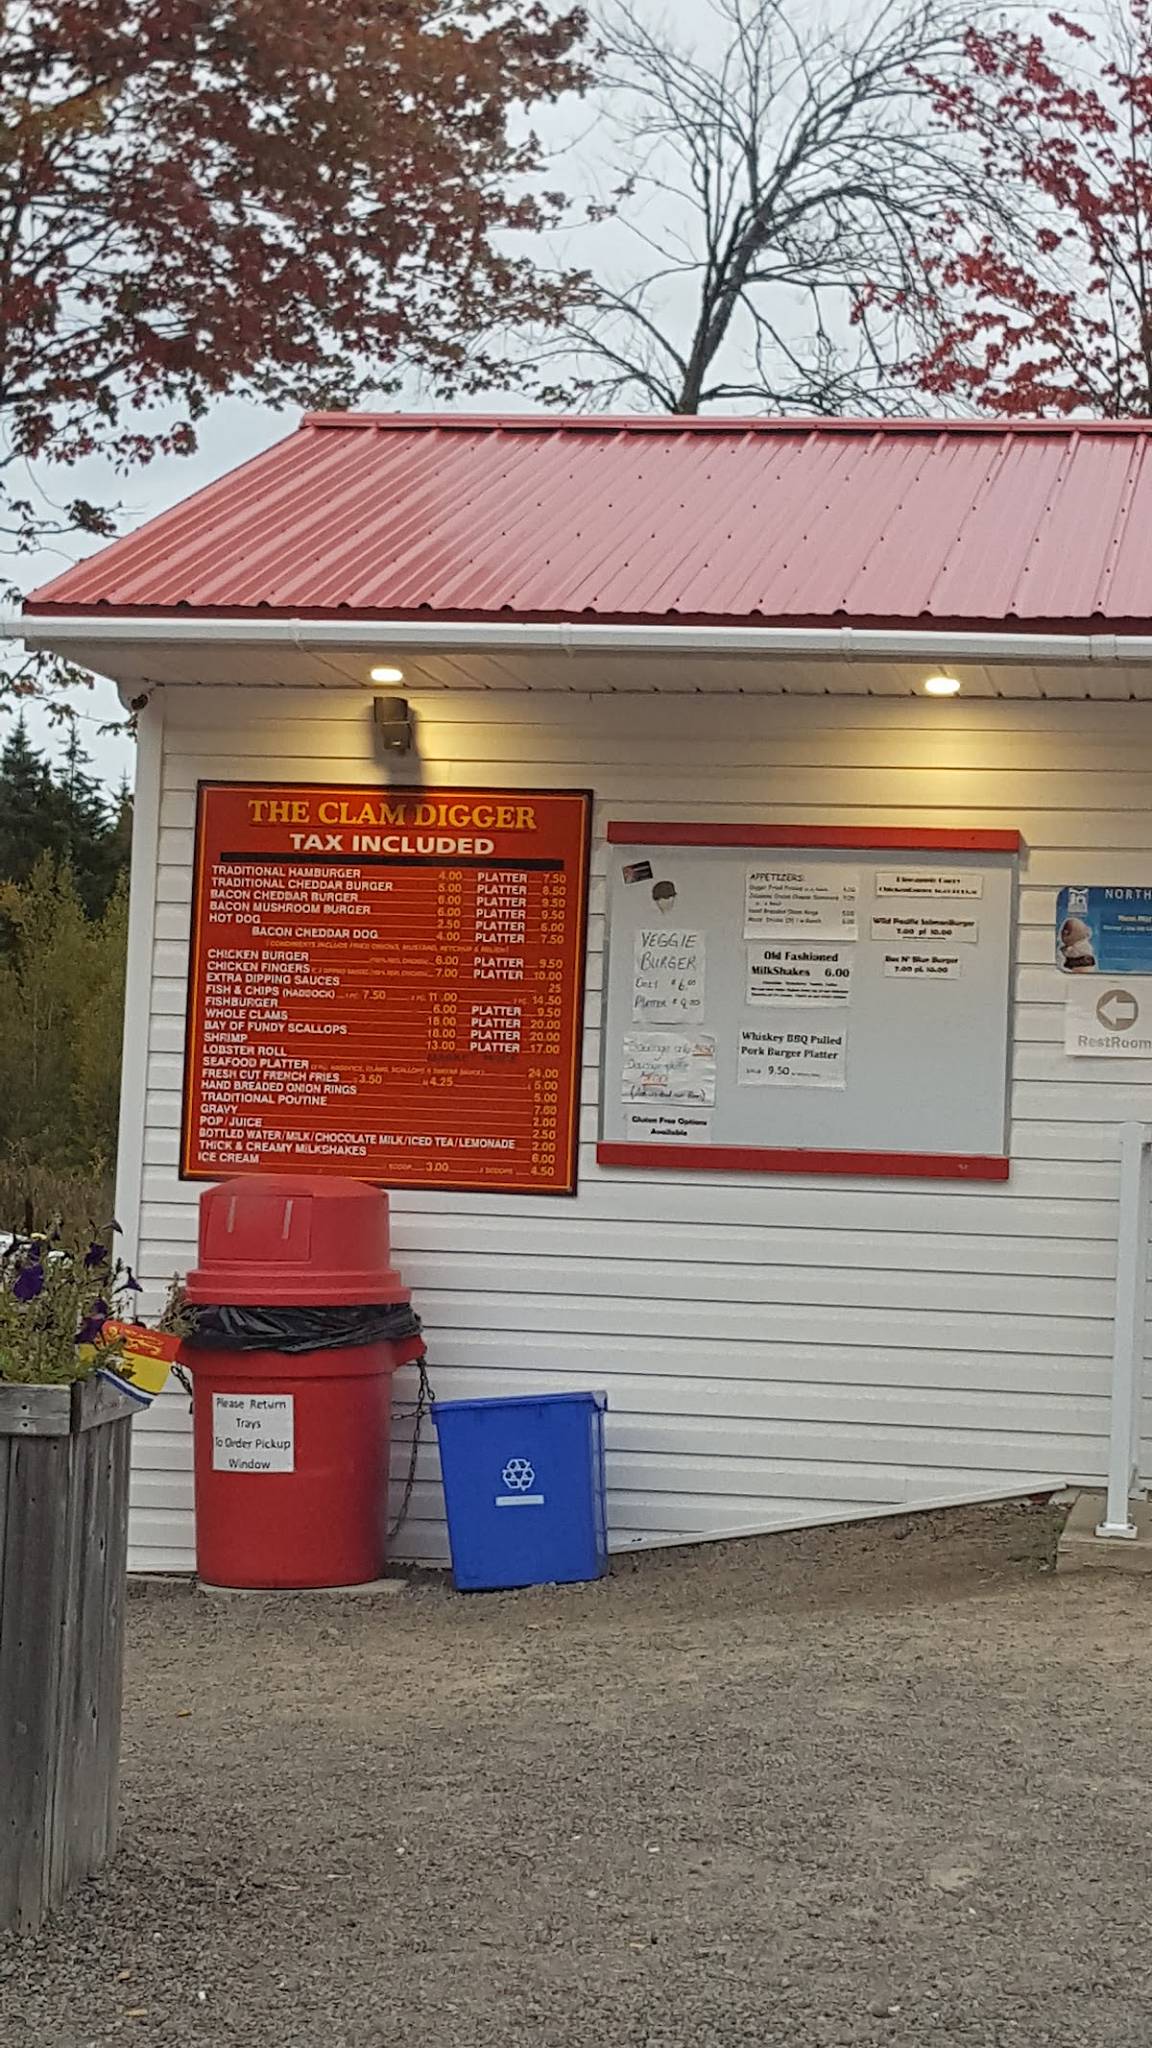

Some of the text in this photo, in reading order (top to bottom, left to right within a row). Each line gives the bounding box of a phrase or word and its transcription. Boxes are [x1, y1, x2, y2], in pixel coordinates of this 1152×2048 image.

[248, 800, 536, 829] THE CLAM DIGGER
[290, 833, 494, 854] TAX INCLUDED
[212, 865, 285, 876] TRADITIONAL
[288, 868, 360, 878] HAMBURGER
[477, 872, 527, 883] PLATTER
[543, 874, 566, 884] 7.50
[211, 877, 285, 888] TRADITIONAL
[288, 879, 343, 890] CHEDDAR
[346, 880, 393, 891] BURGER
[477, 885, 527, 895] PLATTER
[210, 890, 250, 899] BACON
[254, 890, 308, 901] CHEDDAR
[311, 892, 358, 901] BURGER
[476, 897, 527, 907] PLATTER
[210, 902, 249, 911] BACON
[253, 903, 320, 913] MUSHROOM
[323, 905, 370, 914] BURGER
[476, 909, 526, 919] PLATTER
[209, 914, 232, 922] HOT
[236, 915, 261, 924] DOG
[475, 921, 525, 931] PLATTER
[252, 927, 292, 936] BACON
[295, 928, 349, 938] CHEDDAR
[353, 929, 378, 938] DOG
[475, 933, 525, 944] PLATTER
[541, 935, 564, 944] 7.50
[641, 932, 696, 948] VEGGIE
[208, 949, 258, 959] CHICKEN
[262, 951, 309, 961] BURGER
[474, 958, 524, 968] PLATTER
[641, 951, 696, 971] BURGER
[764, 951, 838, 961] Old Fashioned
[207, 961, 258, 972] CHICKEN
[261, 963, 310, 973] FINGERS
[436, 969, 458, 978] 7.00
[473, 970, 523, 980] PLATTER
[534, 972, 562, 981] 10.00
[752, 966, 849, 977] MilkShakes 6.00
[206, 973, 339, 986] EXTRA DIPPING SAUCES
[206, 985, 231, 994] FISH
[234, 986, 241, 994] &
[245, 987, 279, 996] CHIPS
[283, 989, 335, 999] (HADDOCK)
[363, 990, 385, 999] 7.50
[205, 997, 278, 1007] FISHBURGER
[471, 1006, 521, 1016] PLATTER
[205, 1009, 245, 1018] WHOLE
[249, 1010, 288, 1020] CLAMS
[471, 1018, 521, 1028] PLATTER
[204, 1021, 226, 1031] BAY
[230, 1022, 244, 1031] OF
[248, 1023, 284, 1032] FUNDY
[288, 1025, 347, 1034] SCALLOPS
[471, 1031, 520, 1040] PLATTER
[743, 1032, 842, 1045] Whiskey BBQ Pulled
[203, 1045, 287, 1056] LOBSTER ROLL
[204, 1033, 247, 1043] SHRIMP
[470, 1042, 520, 1052] PLATTER
[530, 1044, 560, 1053] 17.00
[742, 1046, 839, 1059] Pork Burger Platter
[202, 1057, 256, 1067] SEAFOOD
[260, 1059, 309, 1069] PLATTER
[768, 1066, 790, 1075] 9.50
[202, 1069, 236, 1079] FRESH
[239, 1071, 260, 1080] CUT
[263, 1071, 306, 1082] FRENCH
[309, 1073, 339, 1083] FRIES
[360, 1075, 382, 1084] 3.50
[430, 1077, 453, 1086] 4.25
[201, 1081, 231, 1090] HAND
[234, 1082, 283, 1092] BREADED
[286, 1084, 321, 1094] ONION
[324, 1085, 357, 1094] RINGS
[201, 1092, 327, 1105] TRADITIONAL POUTINE
[201, 1105, 238, 1114] GRAVY
[199, 1128, 244, 1138] BOTTLED
[651, 1128, 687, 1136] Available
[199, 1140, 231, 1150] THICK
[235, 1142, 242, 1150] &
[246, 1143, 292, 1153] CREAMY
[296, 1145, 367, 1156] MILKSHAKES
[198, 1152, 216, 1161] ICE
[219, 1153, 259, 1163] CREAM
[426, 1163, 448, 1171] 3.00
[217, 1397, 286, 1409] Please Return
[236, 1418, 261, 1429] Trays
[225, 1438, 252, 1448] Order
[256, 1439, 291, 1450] Pickup
[229, 1459, 270, 1469] Window
